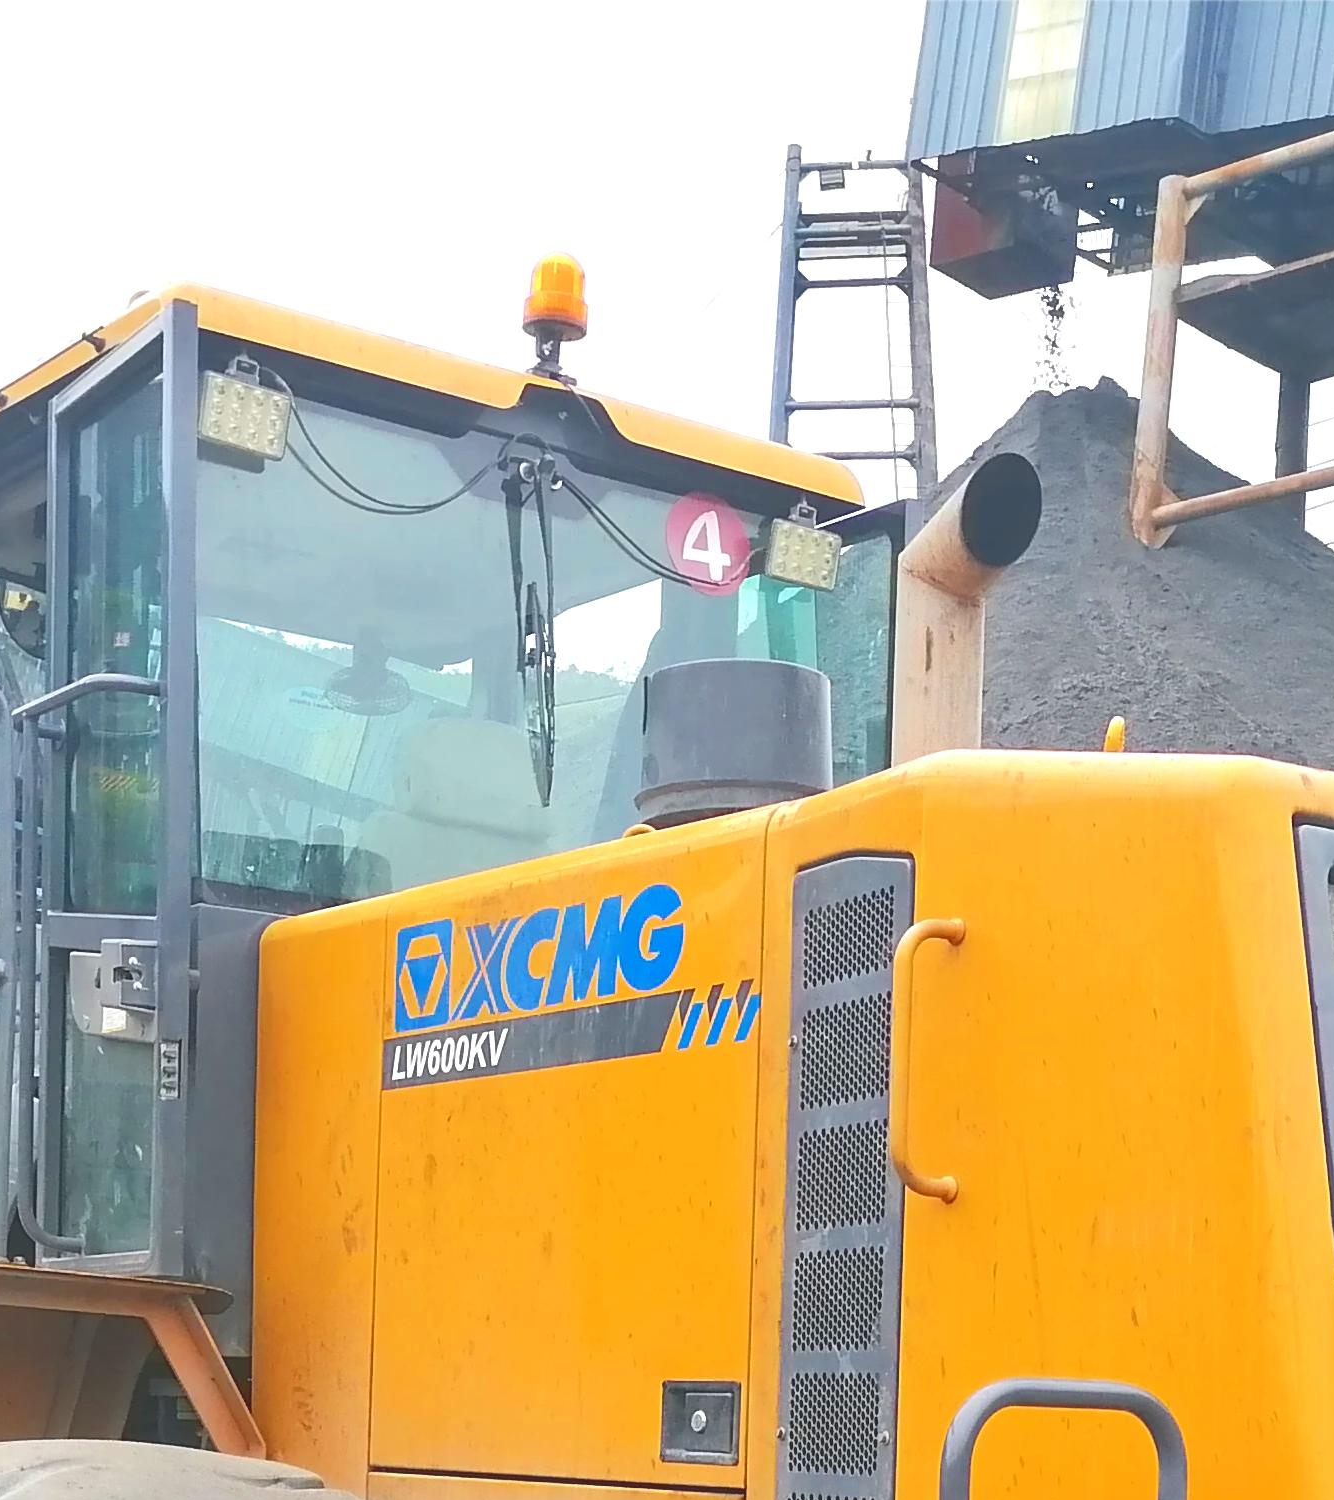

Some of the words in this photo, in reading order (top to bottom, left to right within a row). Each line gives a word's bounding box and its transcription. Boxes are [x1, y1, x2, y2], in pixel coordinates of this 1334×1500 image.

[683, 510, 731, 581] 4
[451, 883, 685, 1021] XCMG
[391, 1027, 508, 1081] LW600KV
